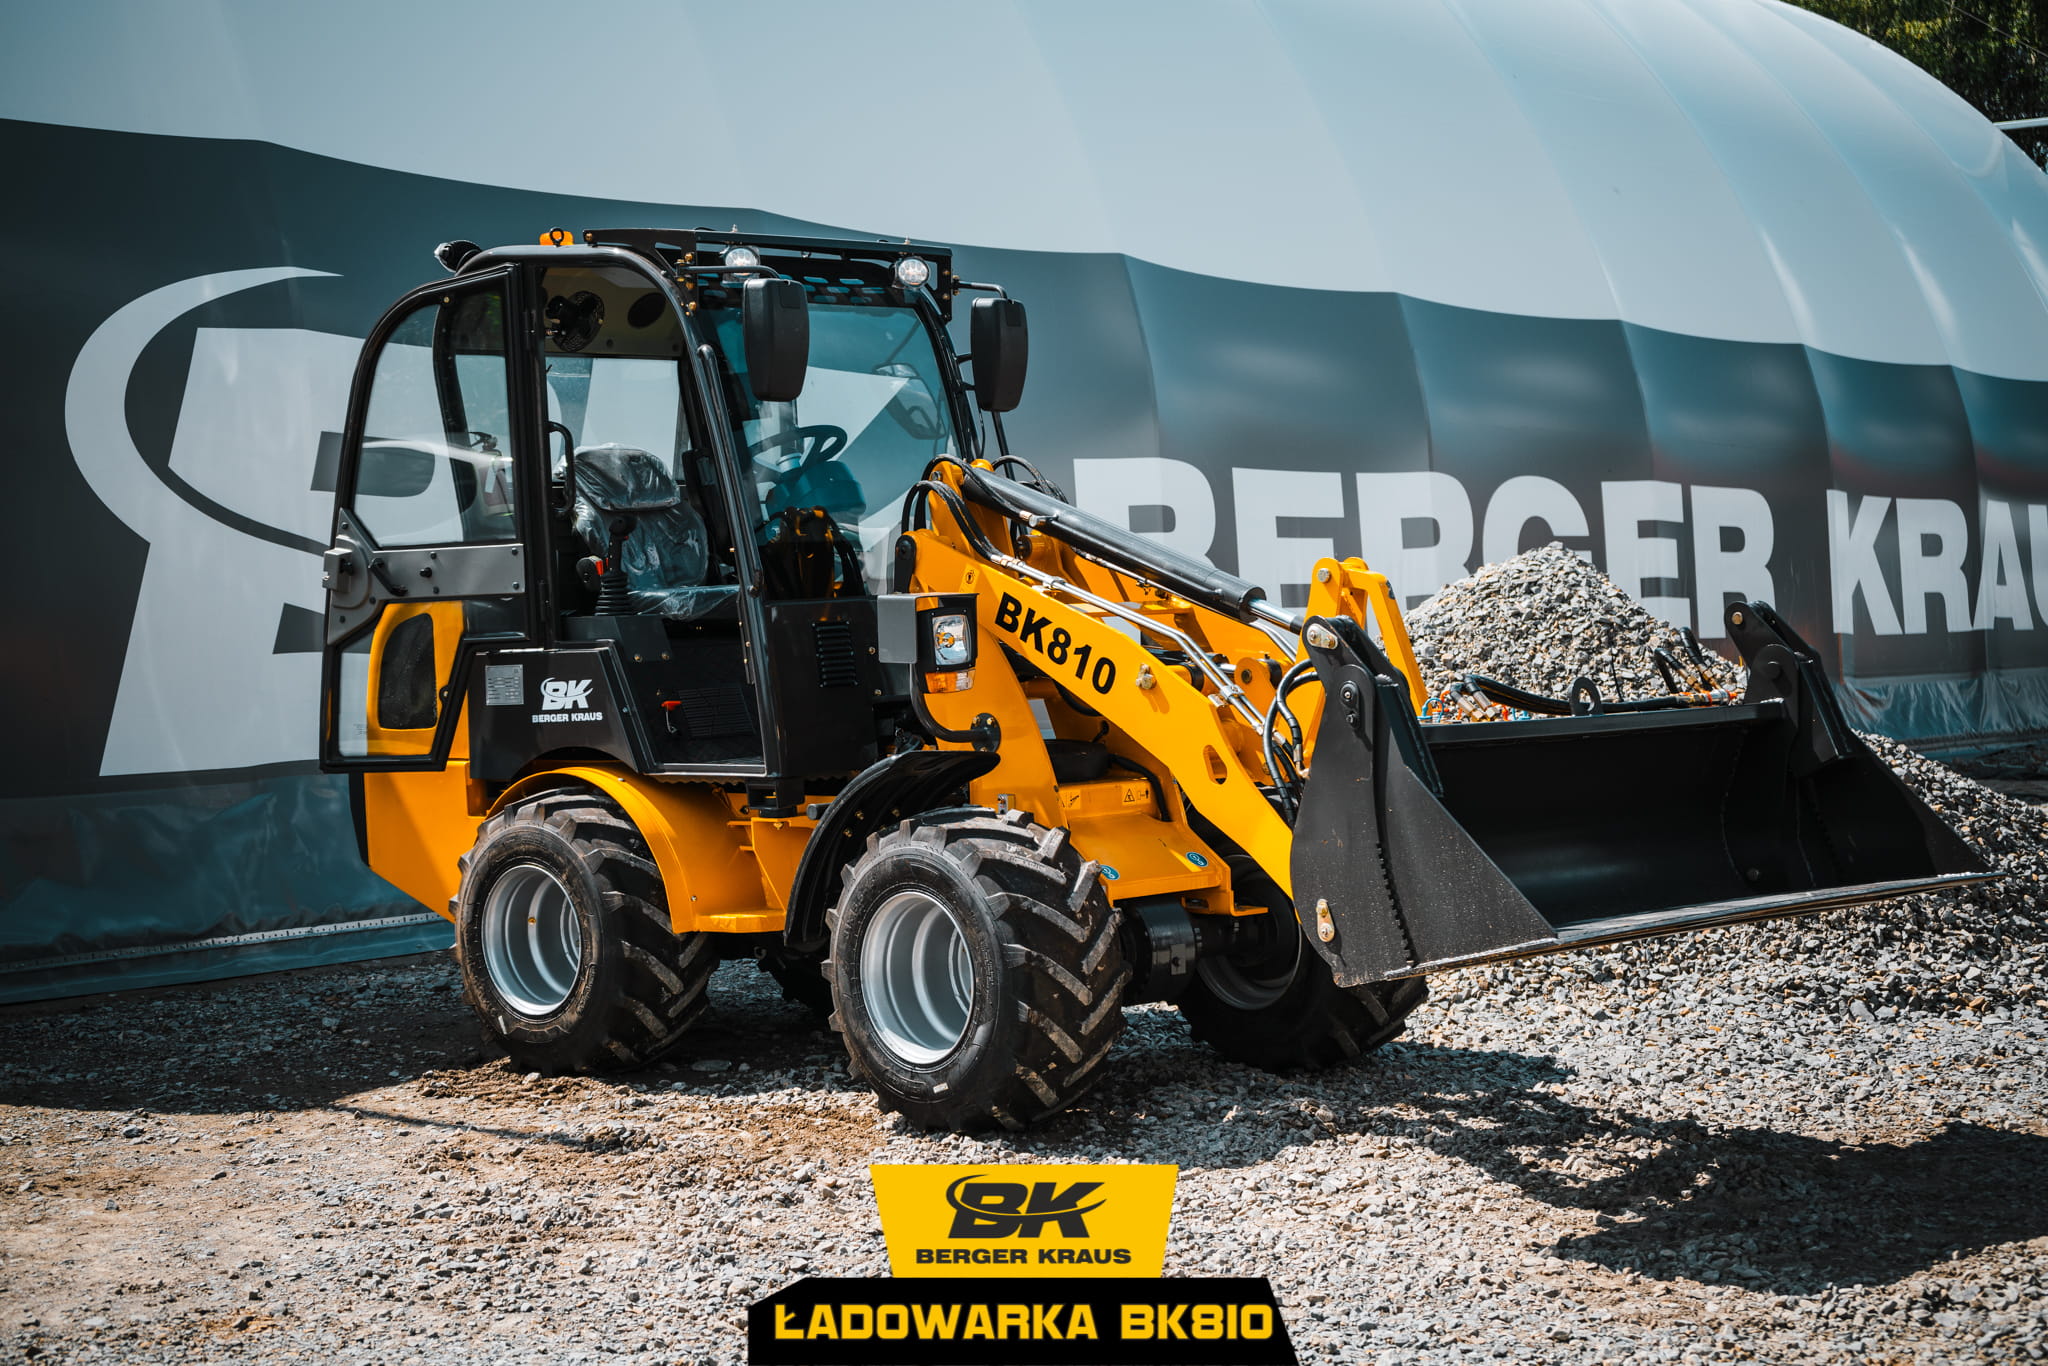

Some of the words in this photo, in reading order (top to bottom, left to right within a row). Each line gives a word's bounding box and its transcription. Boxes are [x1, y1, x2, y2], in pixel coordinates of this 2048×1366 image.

[995, 592, 1116, 694] BK810
[541, 678, 593, 710] BK
[532, 714, 569, 723] BERGER
[571, 712, 603, 721] KRAUS
